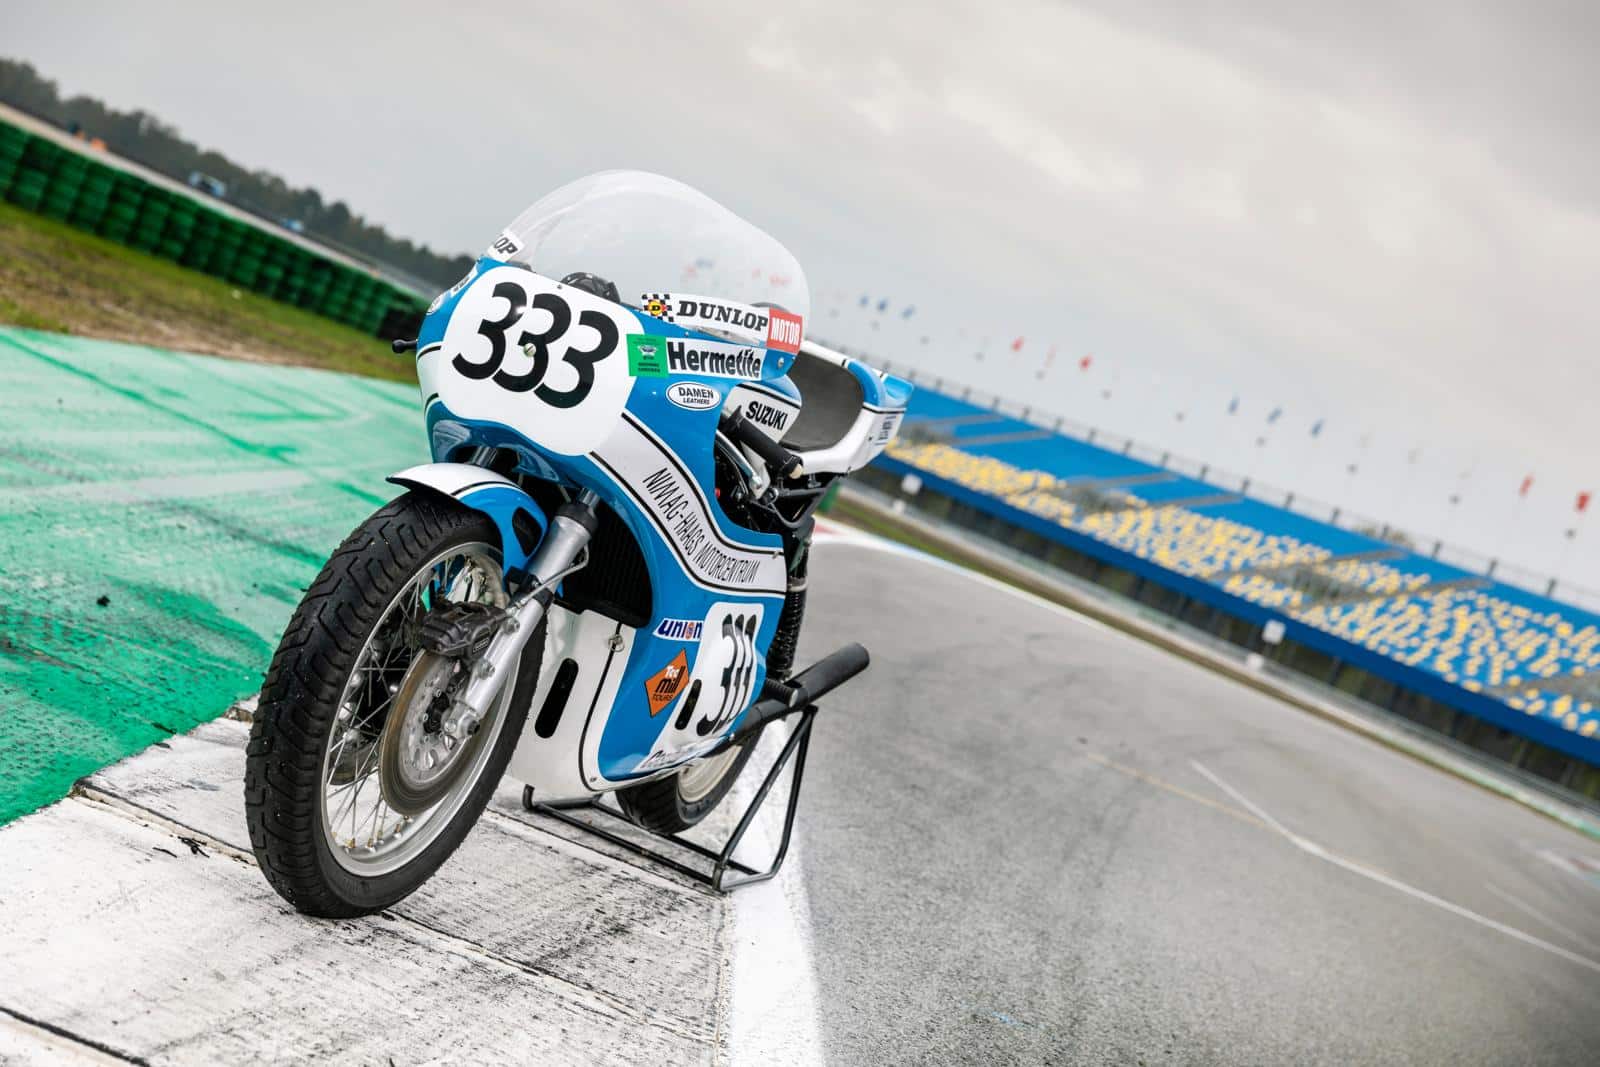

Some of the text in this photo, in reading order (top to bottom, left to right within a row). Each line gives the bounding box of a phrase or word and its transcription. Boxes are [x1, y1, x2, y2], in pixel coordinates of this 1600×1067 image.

[493, 235, 518, 254] OP
[676, 300, 768, 331] DUNLOP
[451, 281, 619, 409] 333
[770, 318, 800, 346] MOTOR
[667, 342, 760, 378] Hermetite
[678, 387, 714, 399] DAMEN
[746, 401, 788, 430] SUZUKI
